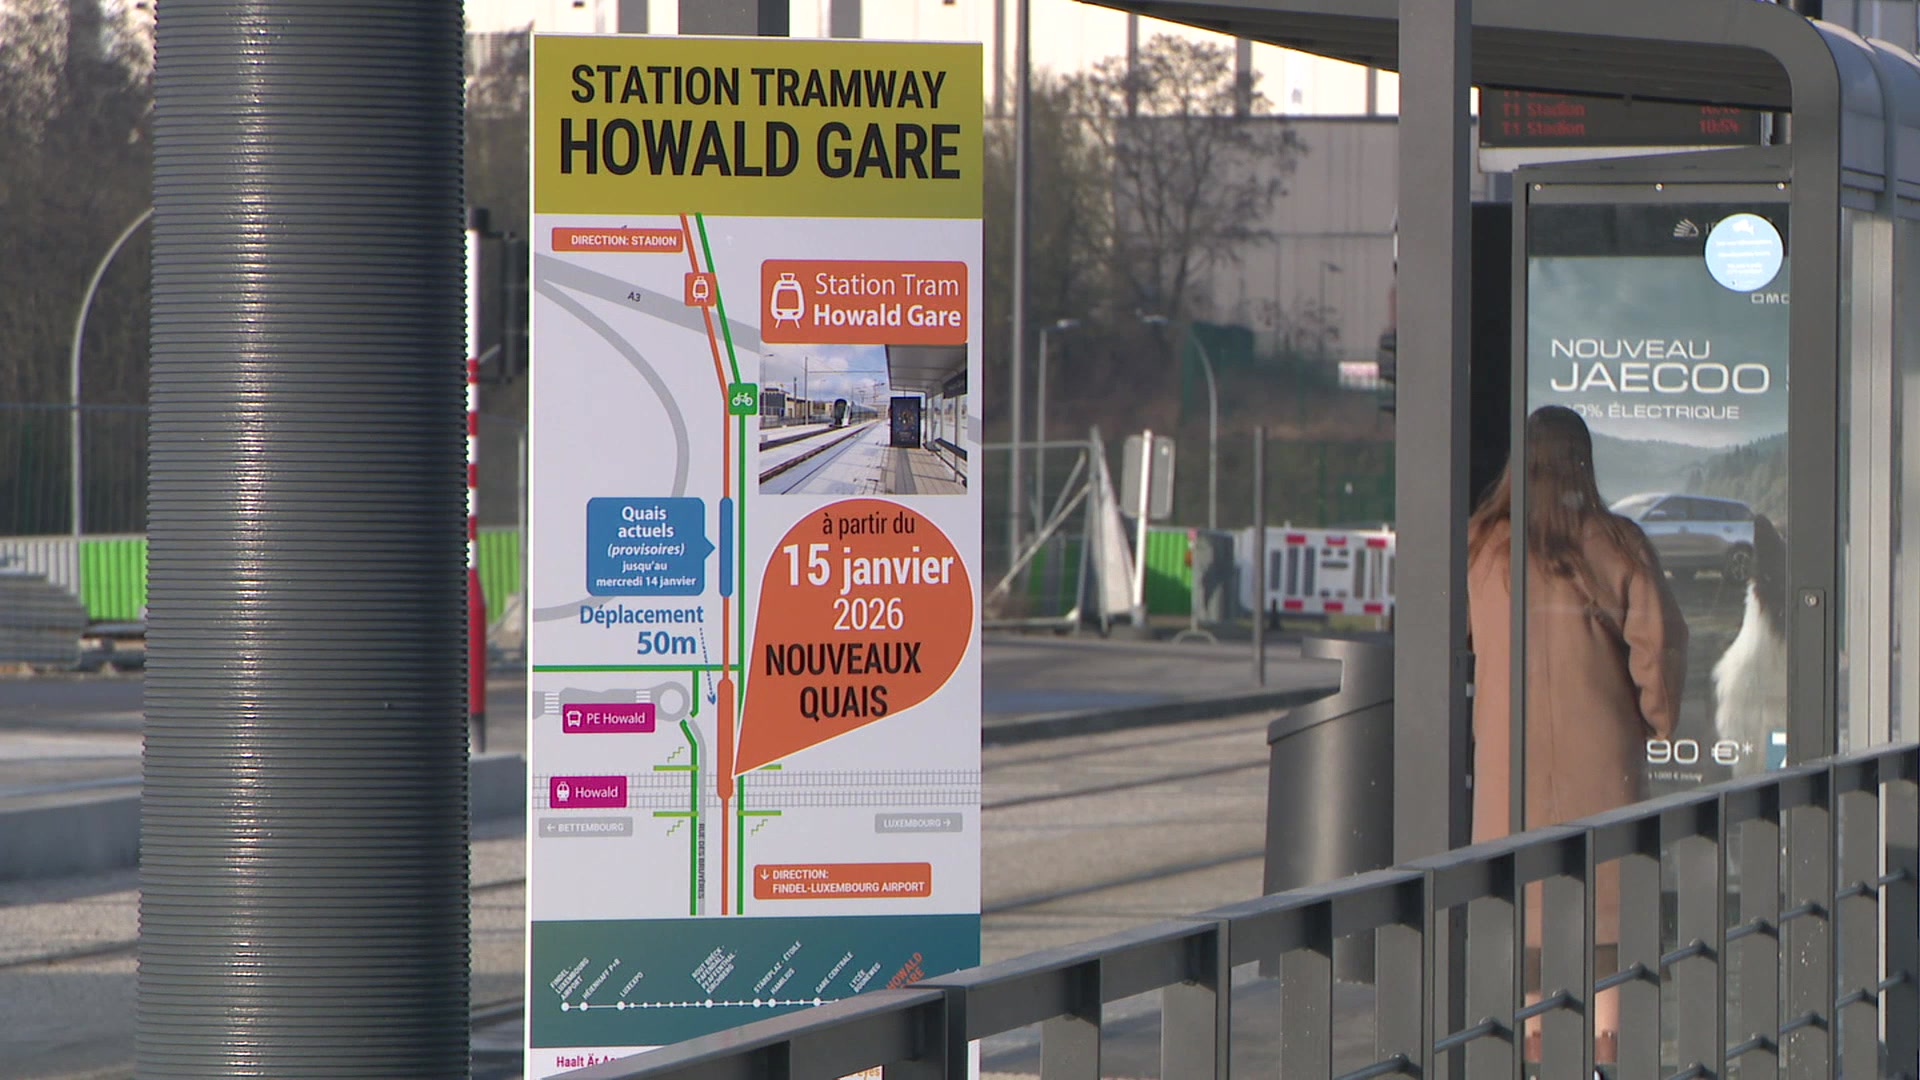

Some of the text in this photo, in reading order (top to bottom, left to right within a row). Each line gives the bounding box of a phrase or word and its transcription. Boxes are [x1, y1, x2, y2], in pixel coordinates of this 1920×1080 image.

[572, 65, 946, 108] STATION TRAMWAY
[1526, 101, 1586, 117] Stadion
[1526, 120, 1586, 136] Stadion
[561, 118, 960, 179] HOWALD GARE
[572, 235, 676, 245] DIRECTION: STADION
[816, 273, 958, 295] Station Tram
[628, 292, 640, 302] A3
[814, 304, 961, 327] Howald Gare
[1552, 339, 1709, 359] NOUVEAU
[1551, 362, 1769, 393] JAECOO
[1608, 403, 1740, 419] ÉLECTRIQUE
[621, 505, 667, 523] Quais
[617, 524, 674, 538] actuels
[823, 511, 916, 540] à partir du
[608, 543, 684, 558] (provisoires)
[622, 561, 667, 573] jusqu'au
[783, 543, 955, 595] 15 janvier
[597, 576, 696, 589] mercredi 14 janvier
[580, 605, 704, 629] Déplacement
[834, 598, 903, 630] 2026
[637, 631, 696, 654] 50m
[766, 642, 921, 676] NOUVEAUX
[800, 685, 889, 719] QUAIS
[587, 712, 645, 724] PE Howald
[1647, 740, 1698, 764] 90
[576, 786, 618, 797] Howald
[558, 823, 624, 832] BETTEMBOURG
[884, 819, 941, 828] LUXEMBOURG
[773, 870, 828, 879] DIRECTION:
[772, 882, 925, 894] FINDEL-LUXEMBOURG AIRPORT
[886, 952, 924, 990] HOWALD
[619, 971, 644, 998] LUXEXPO
[556, 1055, 585, 1067] Haalt
